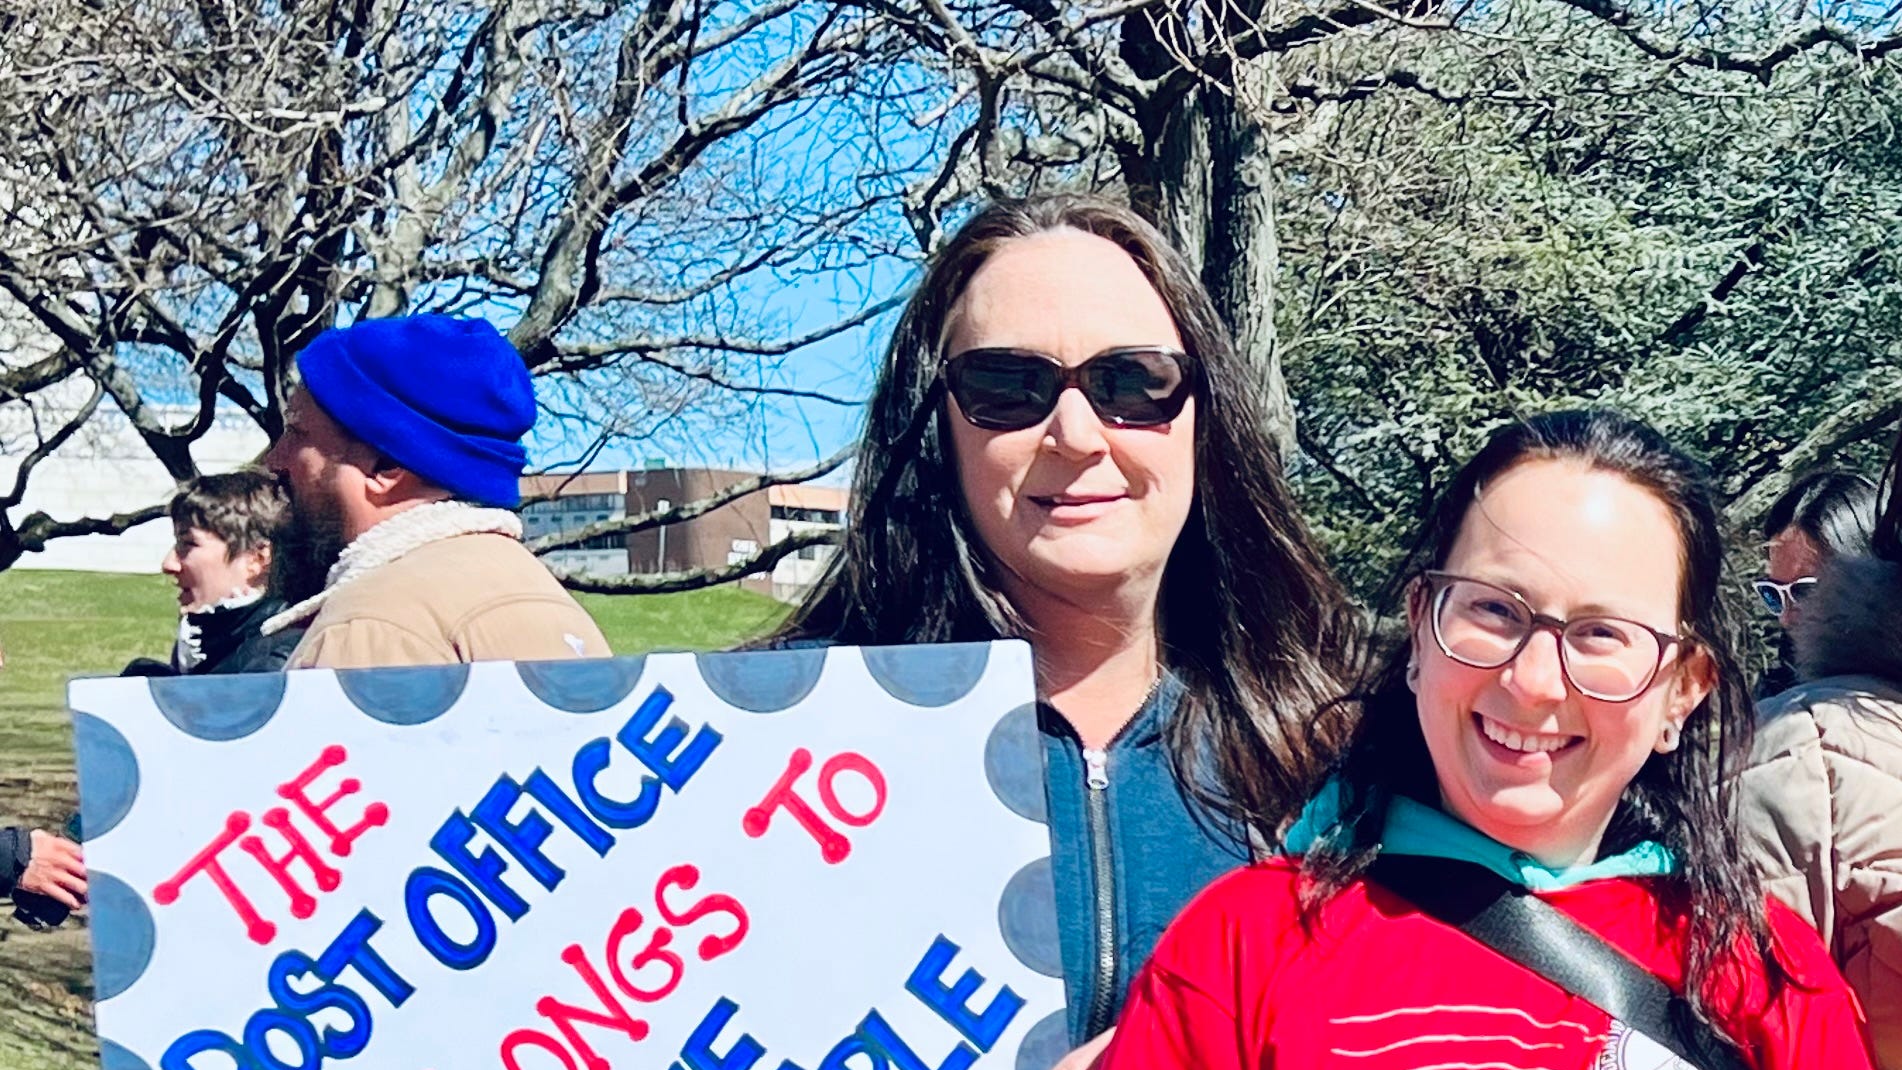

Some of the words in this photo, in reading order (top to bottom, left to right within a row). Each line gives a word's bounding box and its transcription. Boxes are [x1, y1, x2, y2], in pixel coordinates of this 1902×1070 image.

[154, 744, 389, 944] THE
[404, 683, 724, 971] OFFICE
[742, 746, 887, 864] TO
